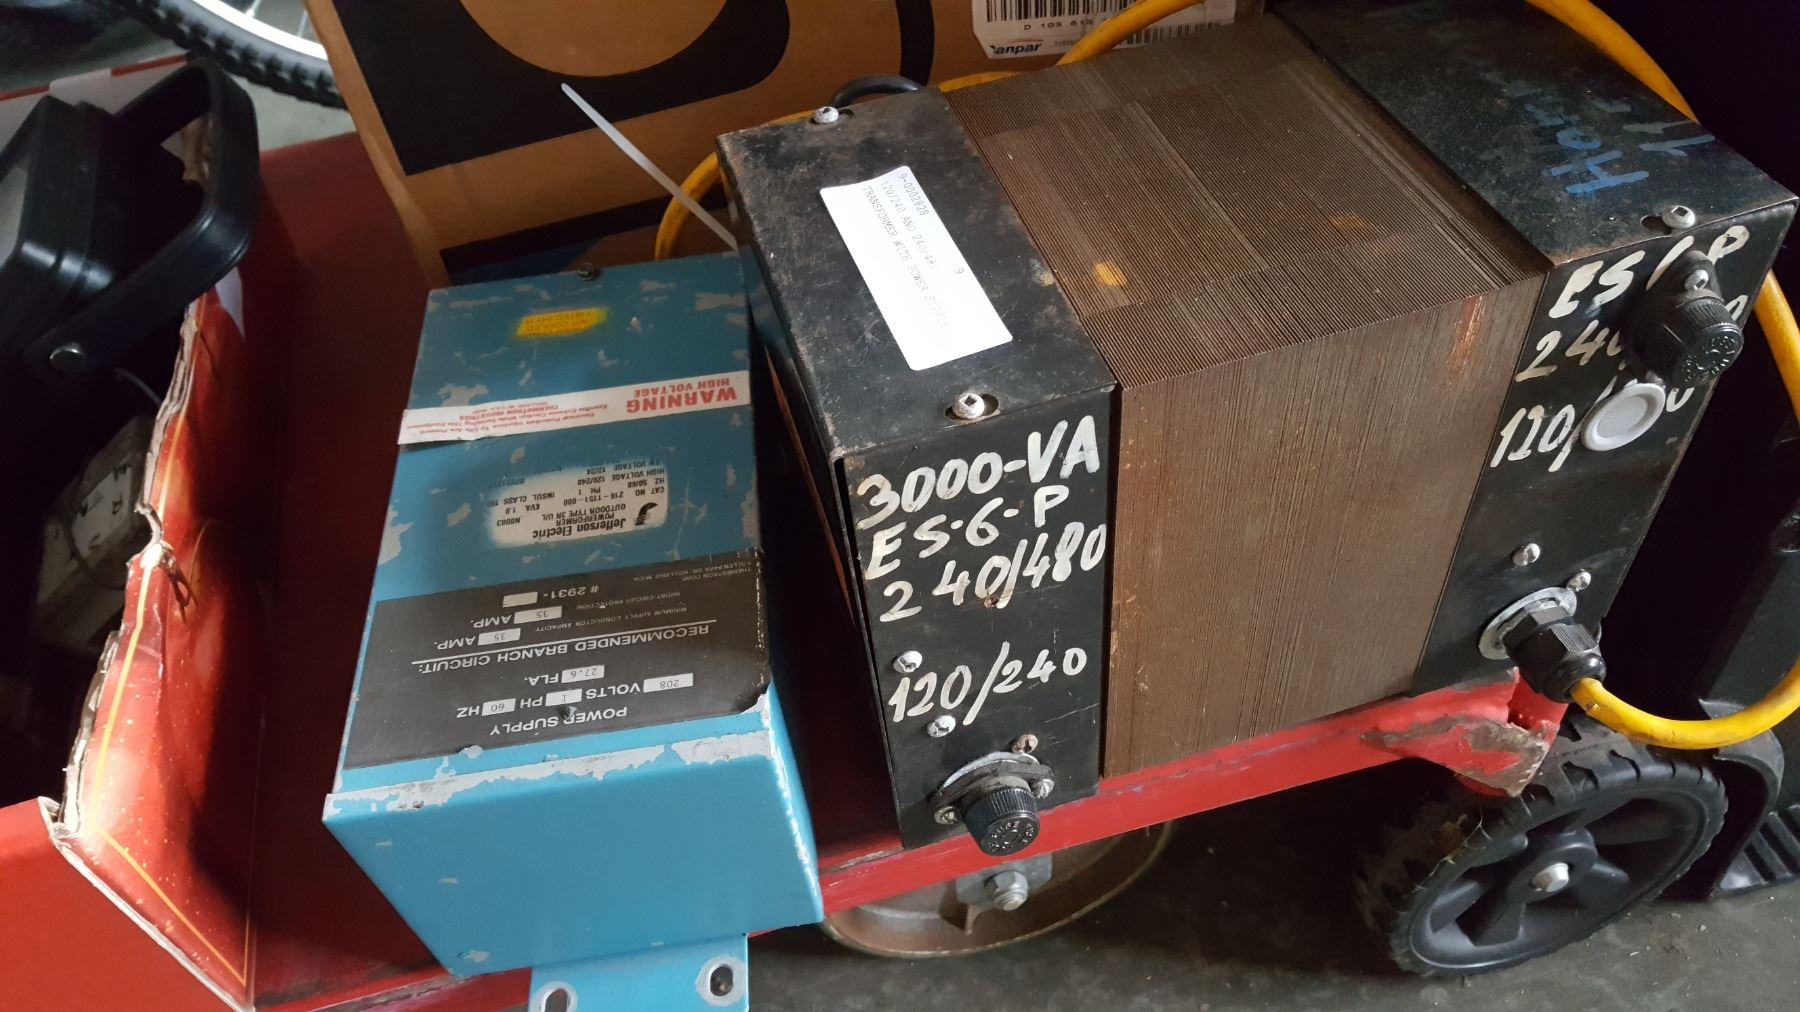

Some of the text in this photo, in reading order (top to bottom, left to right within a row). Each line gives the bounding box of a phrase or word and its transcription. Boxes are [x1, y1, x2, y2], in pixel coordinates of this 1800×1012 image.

[633, 378, 730, 398] HIGH VOLTAGE
[626, 387, 737, 414] WARNING
[611, 471, 644, 481] VOLTAGE
[647, 468, 664, 476] HIGH
[856, 415, 1100, 530] 3000-VA
[503, 496, 527, 505] CLASS
[569, 509, 587, 517] TYPE
[589, 504, 626, 514] OUTDOOR
[556, 513, 614, 526] POWERFORMER
[532, 518, 626, 539] Jefferson Electric
[654, 607, 687, 616] MINIMUM
[470, 615, 512, 628] AMP.
[536, 622, 572, 631] AMPACITY
[575, 615, 622, 626] CONDUCTOR
[418, 624, 709, 674] RECOMMENDED BRANCH CIRCUIT:
[433, 636, 476, 650] AMP.
[524, 667, 598, 686] 27.6 FLA.
[659, 679, 680, 689] 208
[888, 641, 1087, 726] 120/240
[585, 682, 640, 699] VOLTS
[490, 703, 504, 712] 60
[520, 696, 543, 708] PH
[456, 705, 480, 718] HZ
[490, 707, 627, 735] POWER SUPPLY
